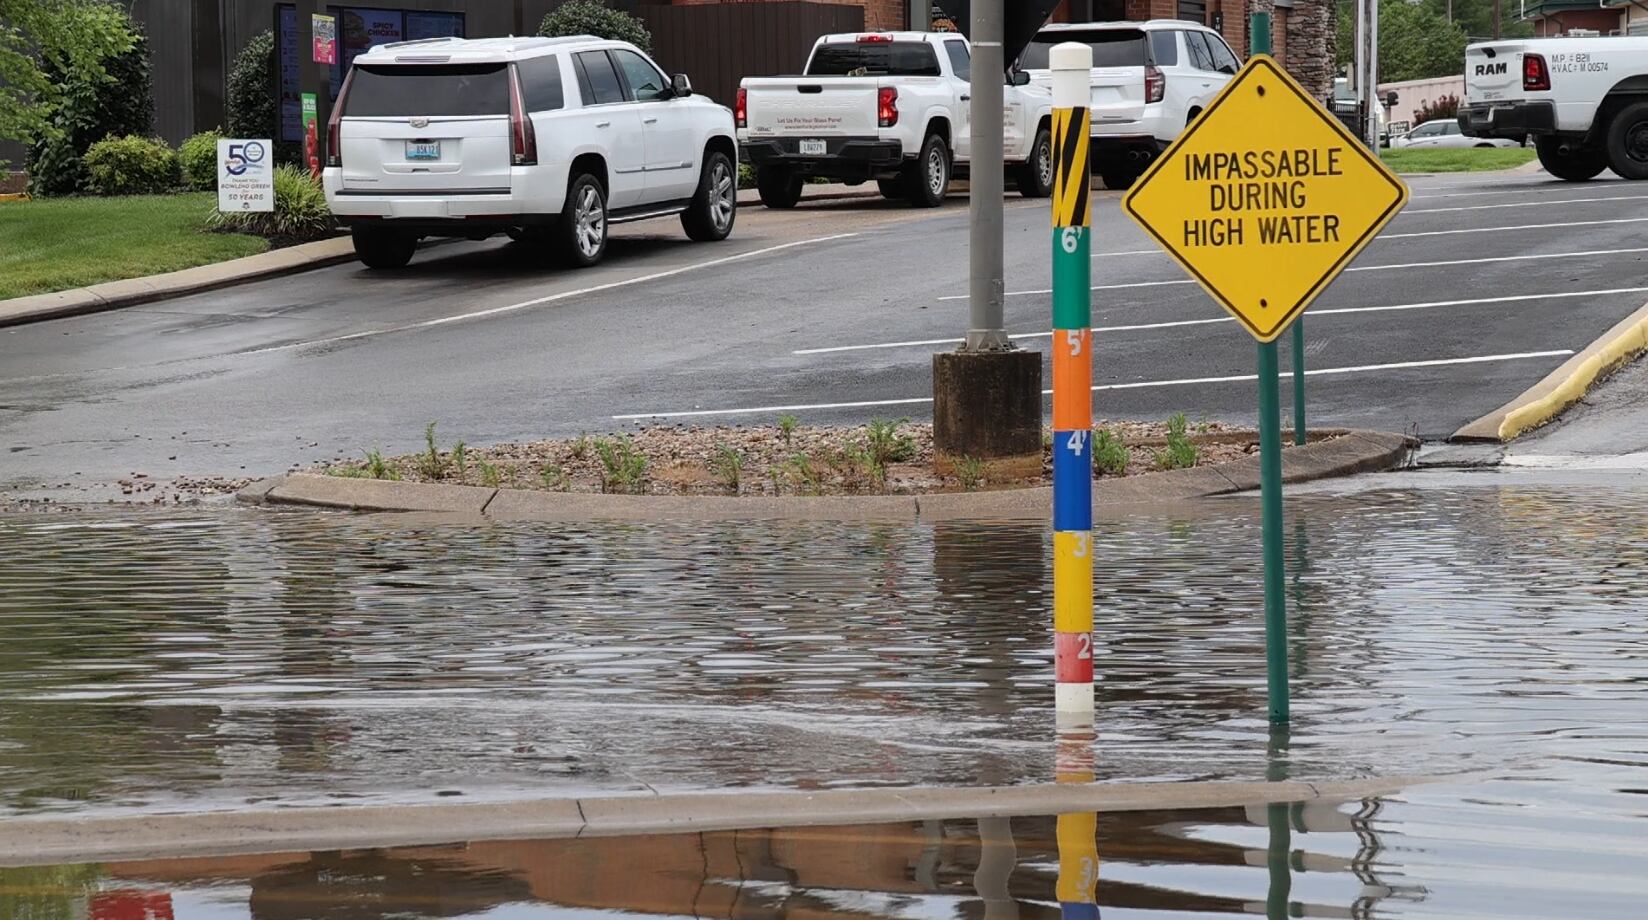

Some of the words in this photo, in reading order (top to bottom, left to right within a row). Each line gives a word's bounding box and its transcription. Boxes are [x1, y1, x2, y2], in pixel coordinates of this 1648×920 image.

[1475, 62, 1507, 76] RAM
[1185, 147, 1343, 181] IMPASSABLE
[239, 193, 264, 201] YEARS
[1210, 180, 1306, 212] DURING
[1184, 218, 1243, 247] HIGH
[1257, 214, 1340, 245] WATER
